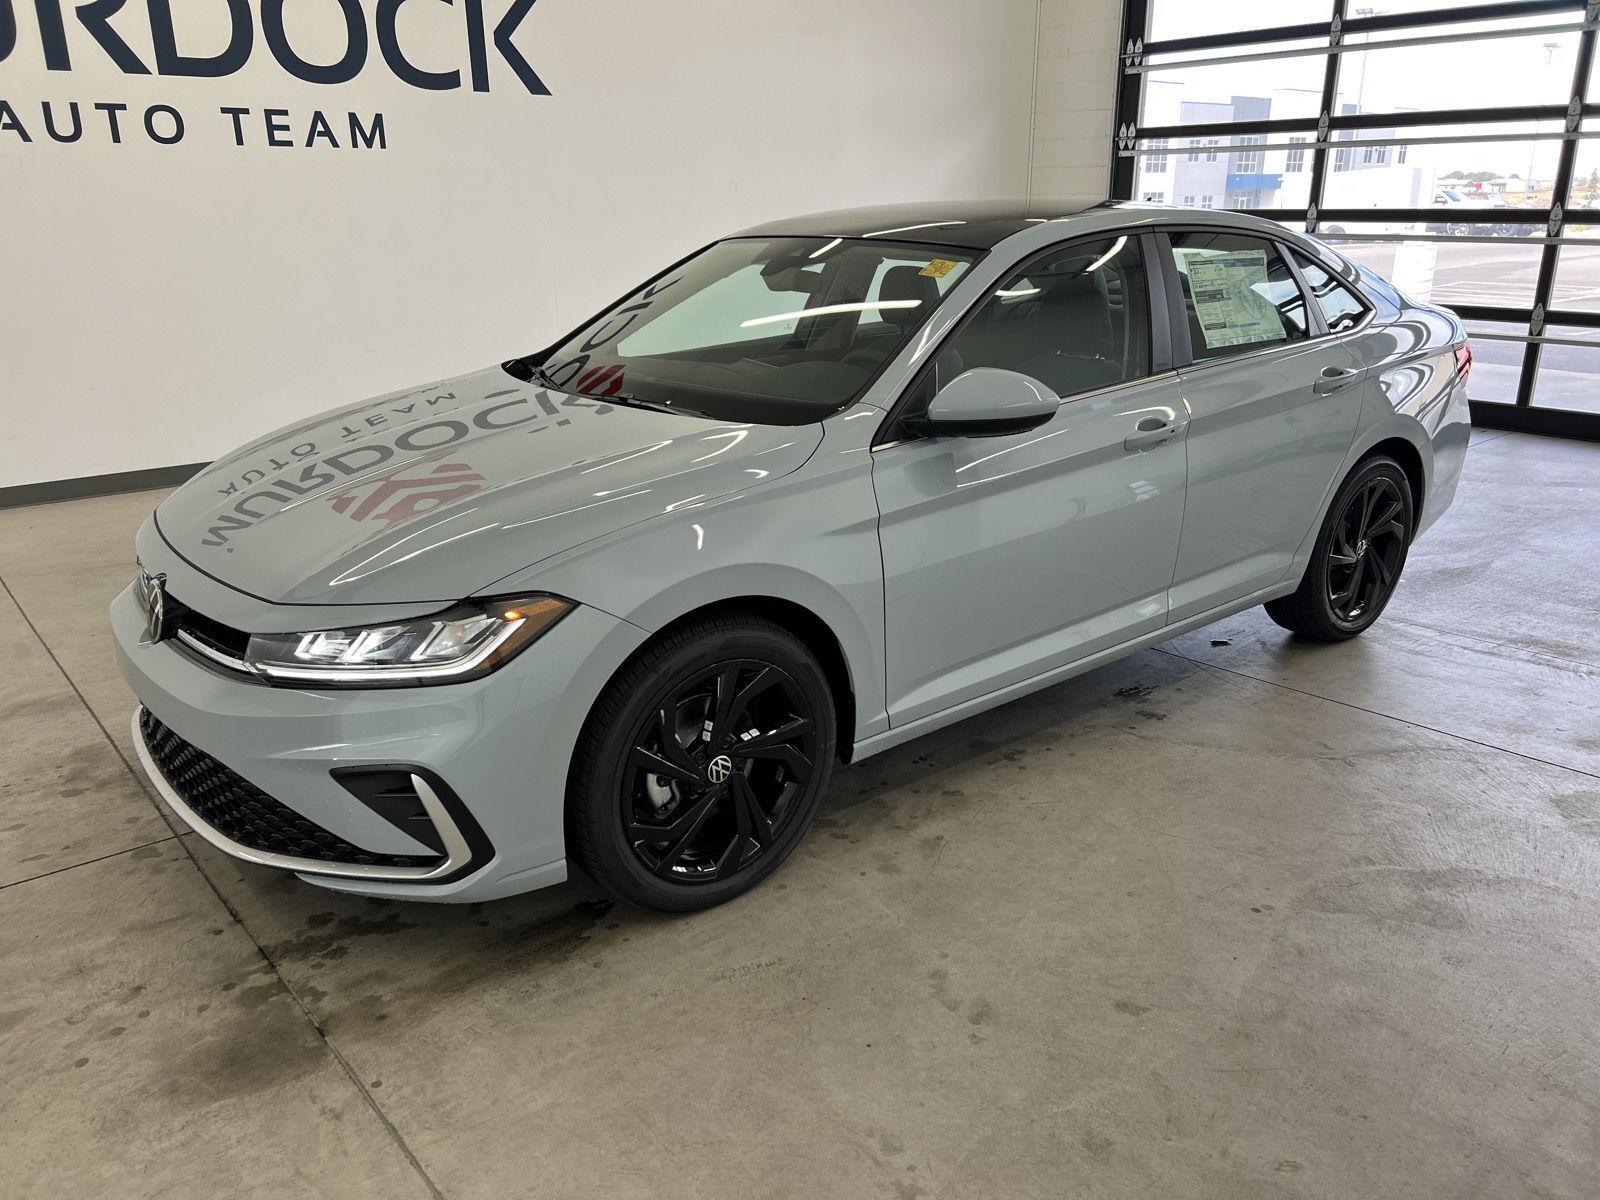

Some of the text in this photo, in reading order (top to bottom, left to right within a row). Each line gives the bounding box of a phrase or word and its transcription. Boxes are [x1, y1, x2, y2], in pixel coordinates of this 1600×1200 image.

[0, 0, 553, 96] RDOCK
[0, 100, 388, 150] AUTO TEAM
